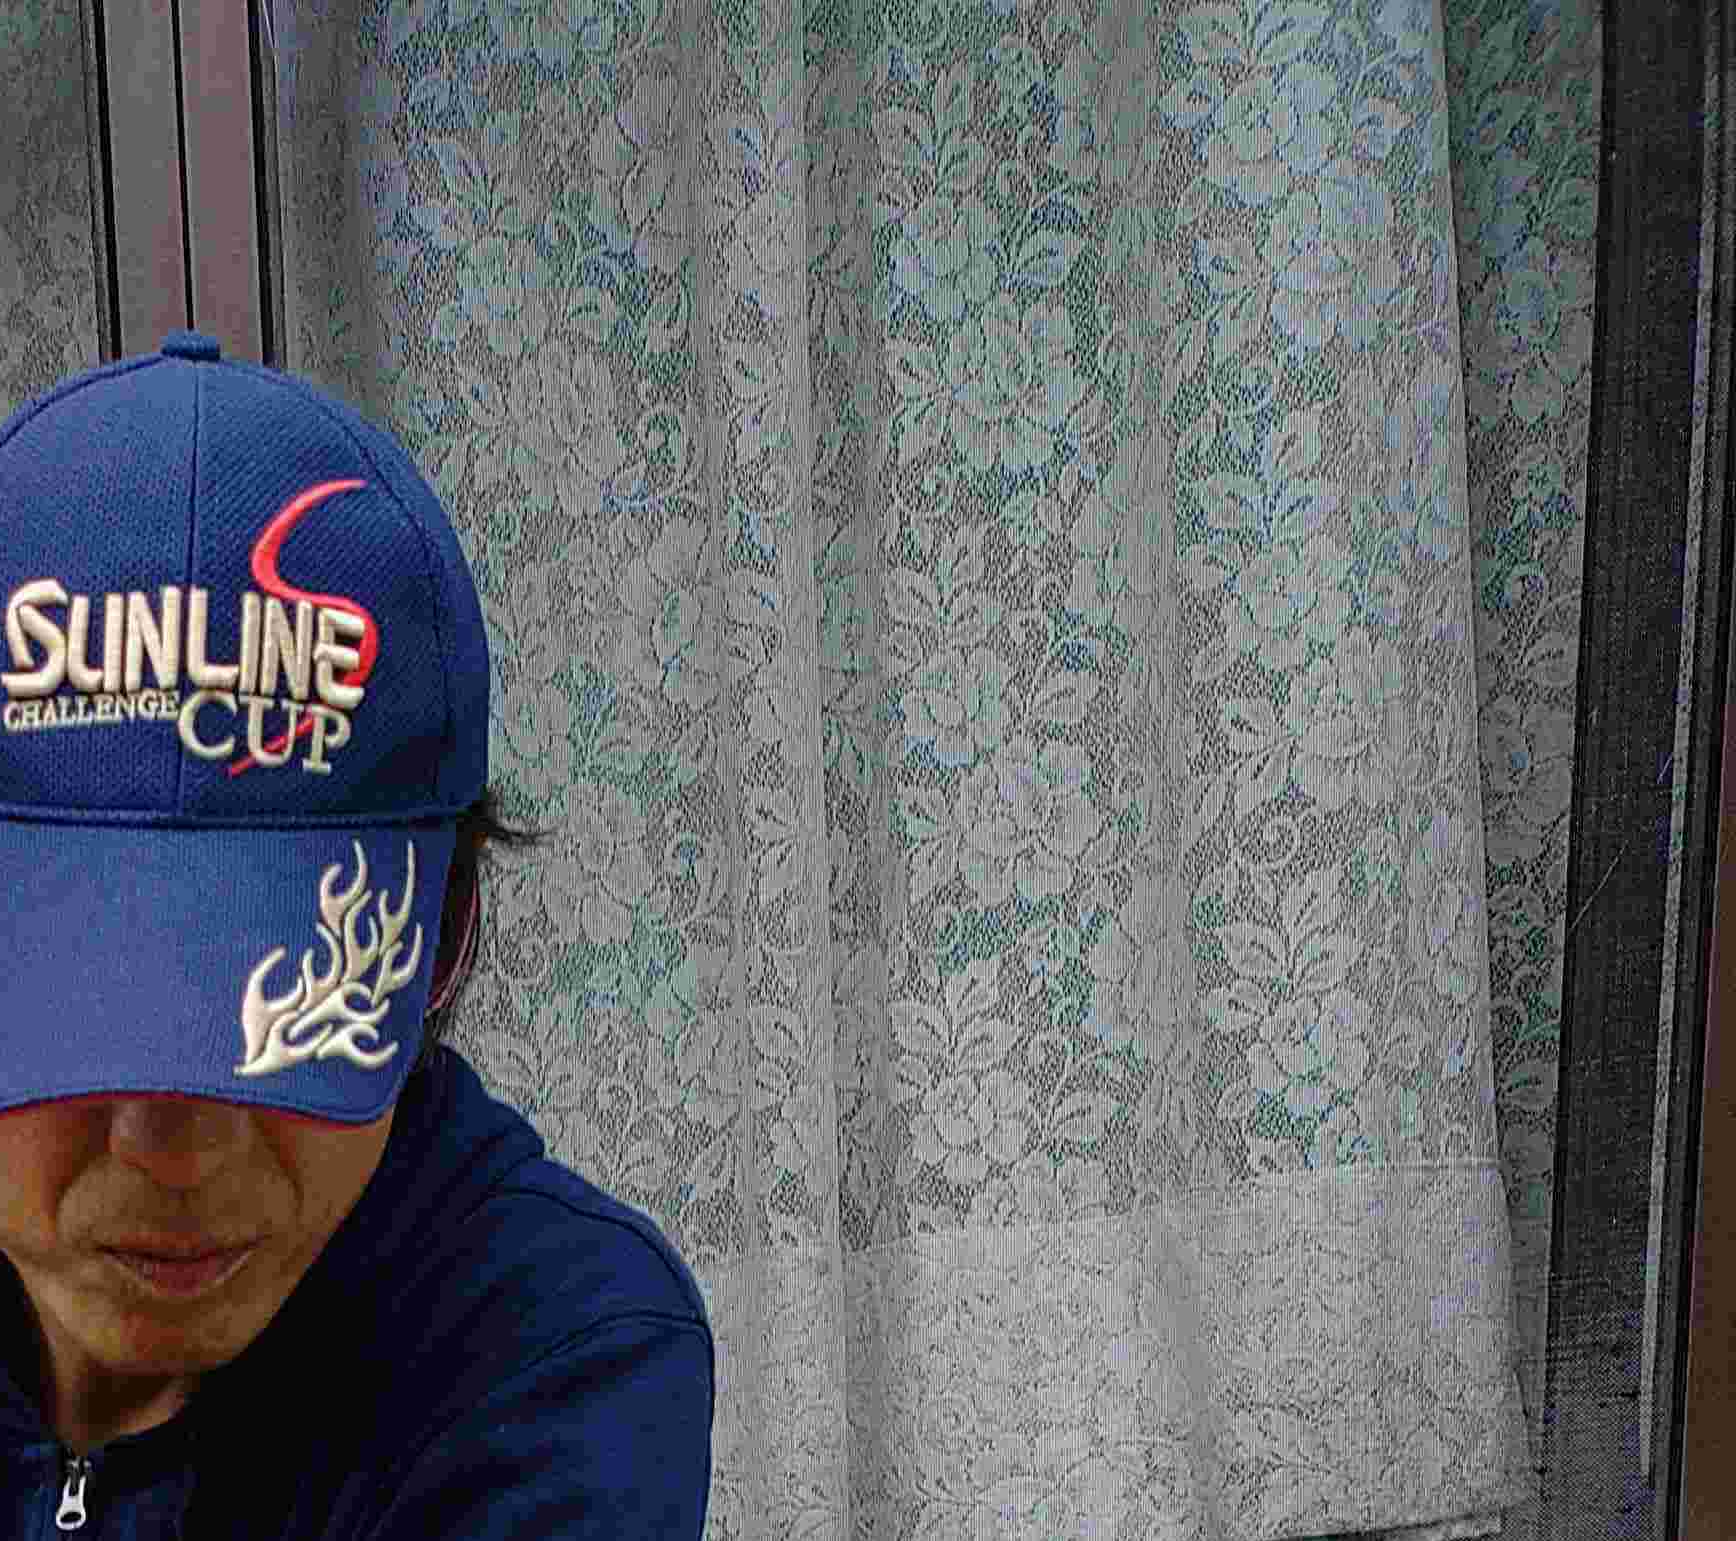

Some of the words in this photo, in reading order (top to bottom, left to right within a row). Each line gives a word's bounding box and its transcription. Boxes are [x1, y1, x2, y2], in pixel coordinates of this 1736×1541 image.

[1, 579, 367, 708] SUNLINE
[3, 690, 179, 733] CHALLENGE
[178, 692, 352, 775] CUP
